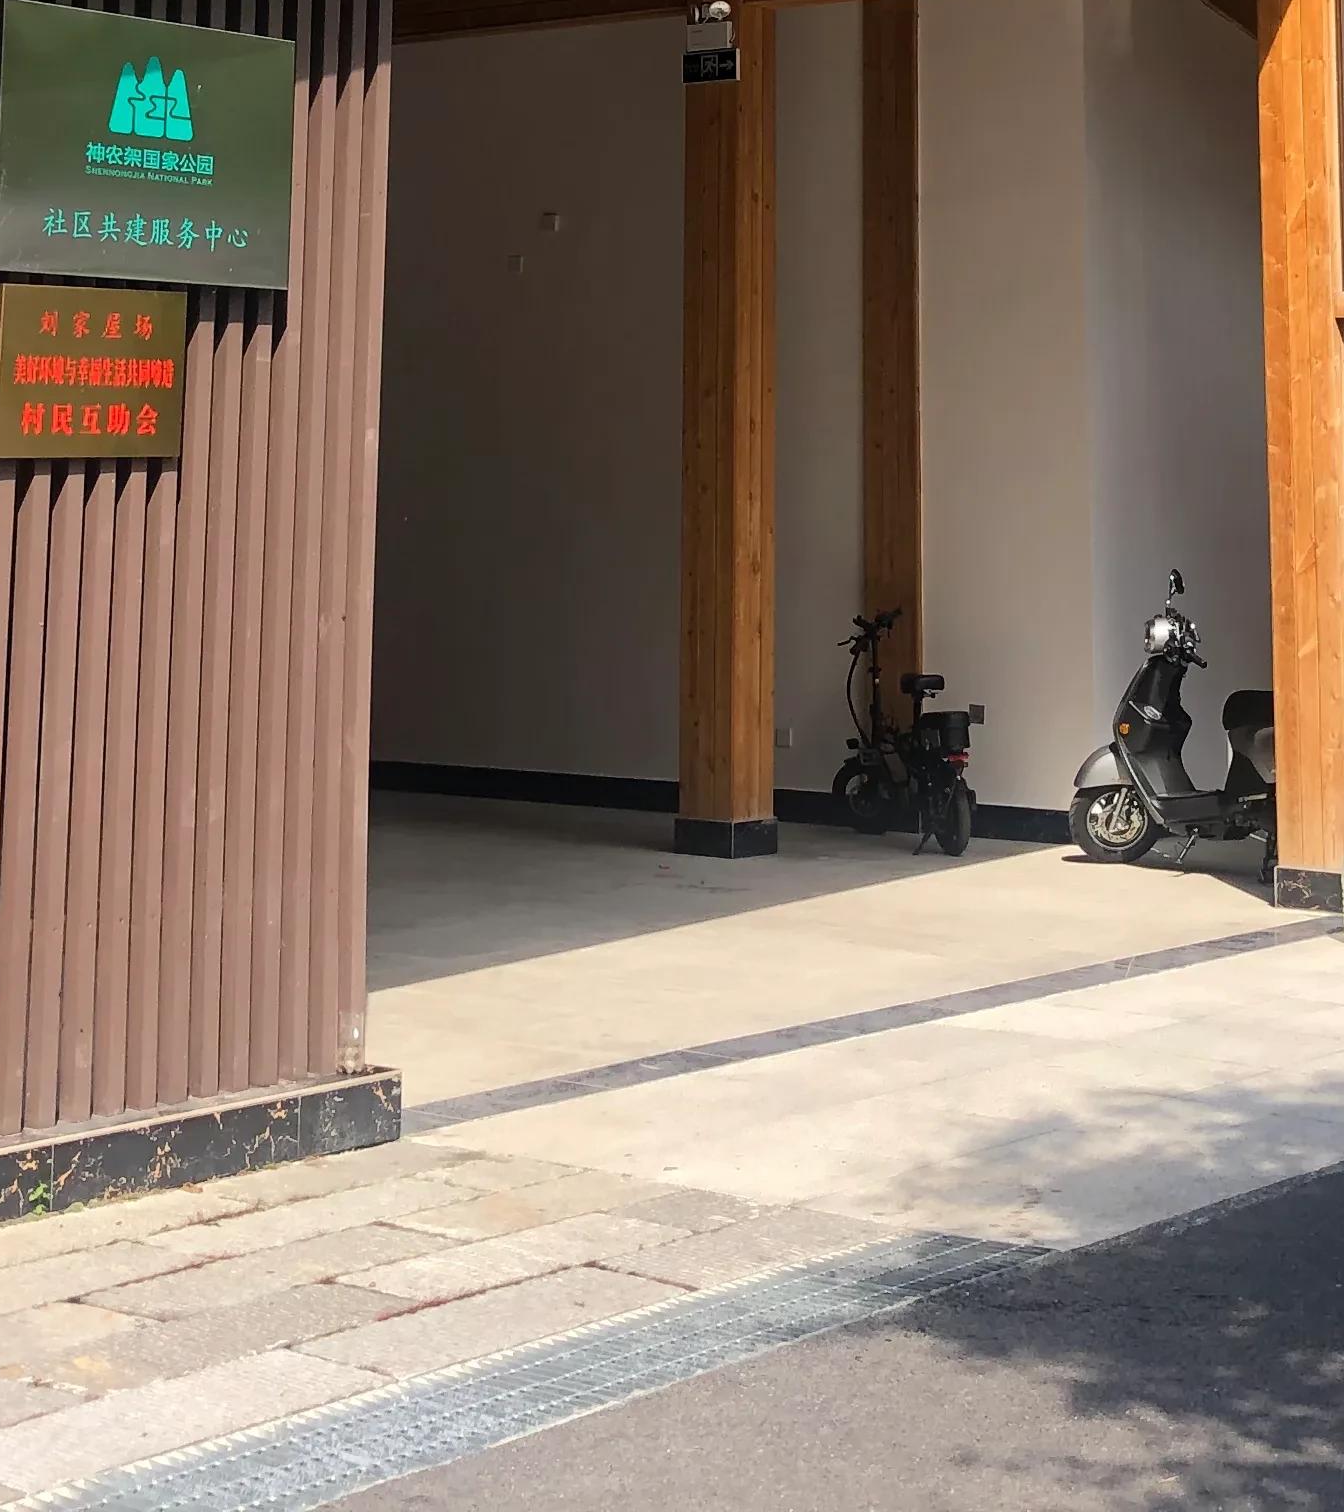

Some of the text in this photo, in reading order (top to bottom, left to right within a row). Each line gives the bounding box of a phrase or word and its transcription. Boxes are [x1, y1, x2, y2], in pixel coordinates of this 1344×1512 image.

[85, 141, 214, 175] 神农架国家公园
[42, 207, 250, 252] 社区共建服务中心
[39, 309, 153, 340] 刘家屋场
[21, 402, 159, 435] 村民互助会
